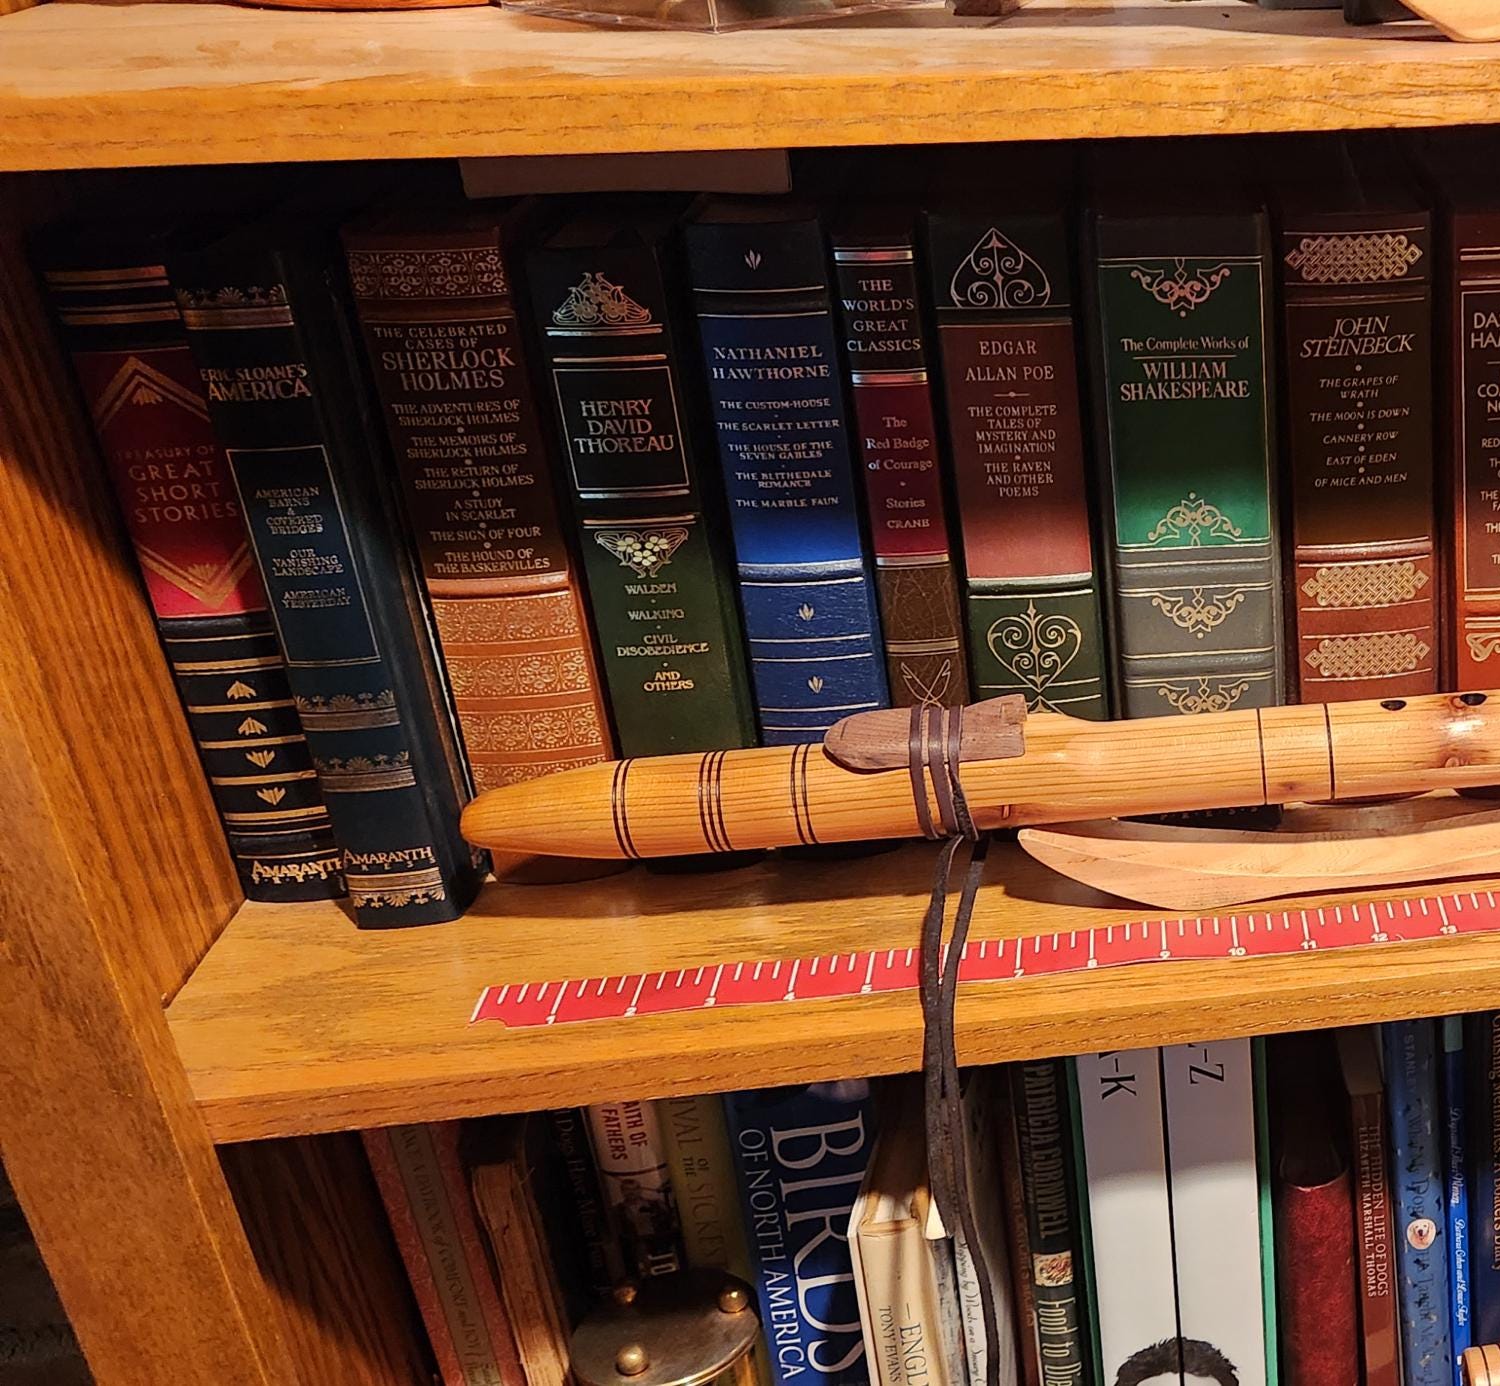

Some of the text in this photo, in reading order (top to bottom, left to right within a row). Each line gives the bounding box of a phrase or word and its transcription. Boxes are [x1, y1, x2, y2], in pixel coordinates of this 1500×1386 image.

[858, 279, 893, 292] THE
[842, 299, 914, 312] WORLD'S
[374, 324, 507, 338] THE CELEBRATED
[853, 320, 908, 332] GREAT
[1334, 316, 1390, 338] JOHN
[405, 338, 478, 349] CASES OF
[846, 339, 921, 351] CLASSICS
[979, 340, 1037, 355] EDGAR
[1121, 336, 1249, 351] The Complete Works of
[1300, 334, 1416, 358] STEINBECK
[382, 348, 516, 371] SHERLOCK
[713, 345, 822, 360] NATHANIEL
[200, 367, 231, 382] ERIC
[712, 365, 830, 380] HAWTHORNE
[965, 365, 1054, 381] ALLAN POE
[1142, 361, 1226, 380] WILLIAM
[401, 369, 505, 391] HOLMES
[1320, 375, 1399, 388] THE GRAPES OF
[207, 377, 312, 401] AMERICA
[1120, 380, 1250, 401] SHAKESPEARE
[1340, 389, 1379, 399] WRATH
[579, 398, 653, 417] HENRY
[968, 405, 1057, 417] THE COMPLETE
[587, 418, 653, 435] DAVID
[742, 422, 793, 431] SCARLET
[882, 416, 907, 428] The
[976, 429, 1056, 441] MYSTERY AND
[1323, 431, 1398, 444] CANNERY ROW
[1481, 437, 1500, 448] RED
[573, 434, 675, 454] THOREAU
[866, 438, 930, 451] Red Badge
[978, 442, 1055, 454] IMAGINATION
[128, 460, 215, 481] GREAT
[984, 461, 1051, 473] THE RAVEN
[135, 481, 220, 503] SHORT
[134, 501, 239, 524] STORIES
[434, 558, 550, 573] THE BASKERVILLES
[624, 583, 677, 595] WALDEN
[643, 634, 678, 645] CIVIL
[617, 642, 709, 657] DISOBEDIENCE
[643, 679, 694, 692] OTHERS
[343, 846, 432, 865] AMARANTH
[1228, 948, 1246, 956] 10
[1301, 940, 1317, 949] 11
[1371, 933, 1388, 941] 12
[600, 1109, 628, 1162] FATHERS
[1032, 1149, 1069, 1240] CORNWELL
[768, 1109, 866, 1374] BIRDS
[738, 1128, 806, 1380] OF NORTH AMERICA
[1374, 1214, 1389, 1297] LIFE DOGS
[1365, 1253, 1377, 1297] THOMAS
[1037, 1297, 1079, 1367] Food to
